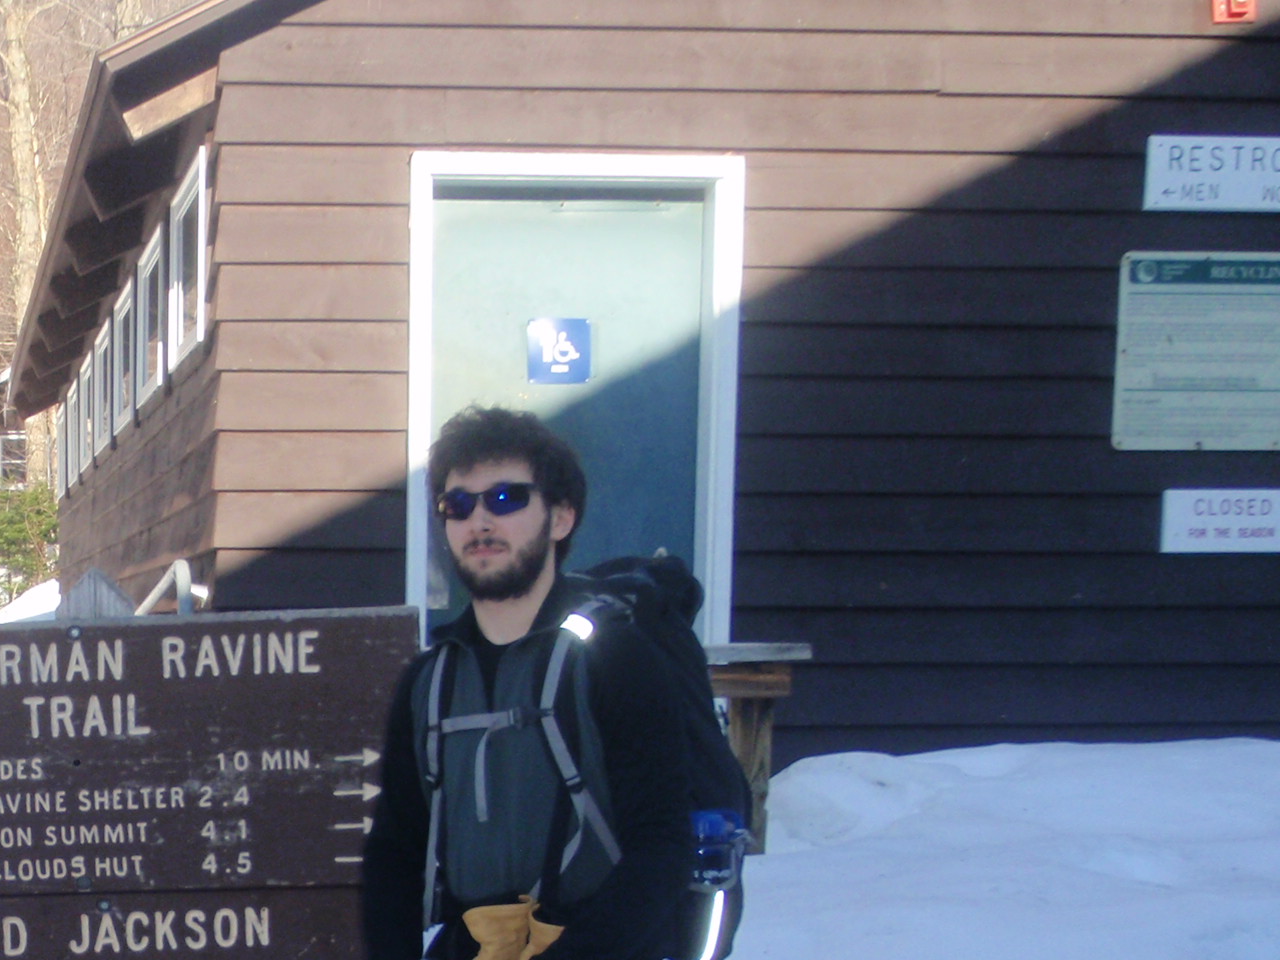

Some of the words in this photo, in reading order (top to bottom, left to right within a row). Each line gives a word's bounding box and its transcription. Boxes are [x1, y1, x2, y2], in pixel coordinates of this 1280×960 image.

[1180, 182, 1220, 201] MEN
[1193, 498, 1273, 516] CLOSED
[161, 630, 321, 679] RAVINE
[23, 694, 152, 738] TRAIL
[216, 750, 250, 771] 10
[261, 749, 320, 771] MIN.
[77, 786, 185, 812] SHELTER
[198, 785, 250, 808] 2.4
[43, 821, 148, 846] SUMMIT
[94, 855, 144, 878] HUT
[201, 851, 253, 874] 4.5
[69, 906, 271, 954] JACKSON
